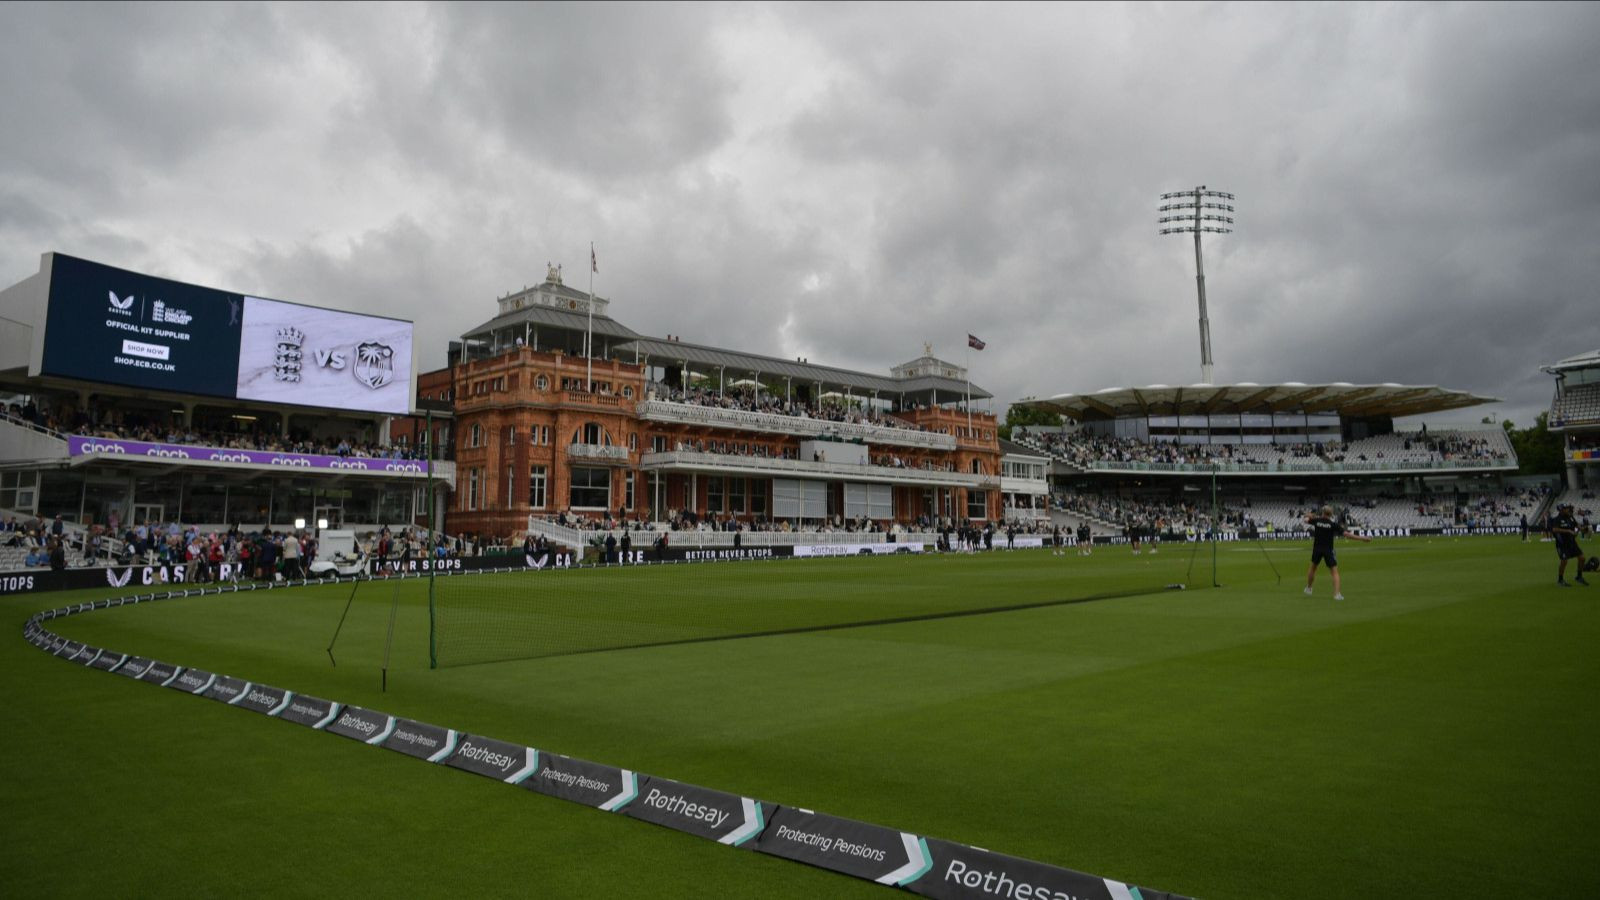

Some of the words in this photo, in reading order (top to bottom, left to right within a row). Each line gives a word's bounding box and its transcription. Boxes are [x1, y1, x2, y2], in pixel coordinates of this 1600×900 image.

[106, 320, 139, 332] OFFICIAL
[141, 327, 153, 335] KIT
[155, 329, 190, 340] SUPPLIER
[127, 344, 145, 352] SHOP
[114, 356, 175, 372] SHOP.ECB.CO.UK
[314, 349, 346, 369] VS
[81, 439, 125, 454] cinch
[685, 551, 716, 559] BETTER
[719, 550, 746, 558] NEVER
[748, 549, 772, 557] STOPS
[0, 576, 34, 591] TOPS
[338, 713, 380, 735] Rothesay
[458, 742, 517, 772] Rothesay
[541, 767, 576, 787] Protecting
[575, 776, 610, 793] Pensions
[644, 788, 730, 829] Rothesay
[776, 825, 832, 851] Protecting
[832, 838, 886, 862] Pensions
[944, 859, 1088, 900] Rothesa
